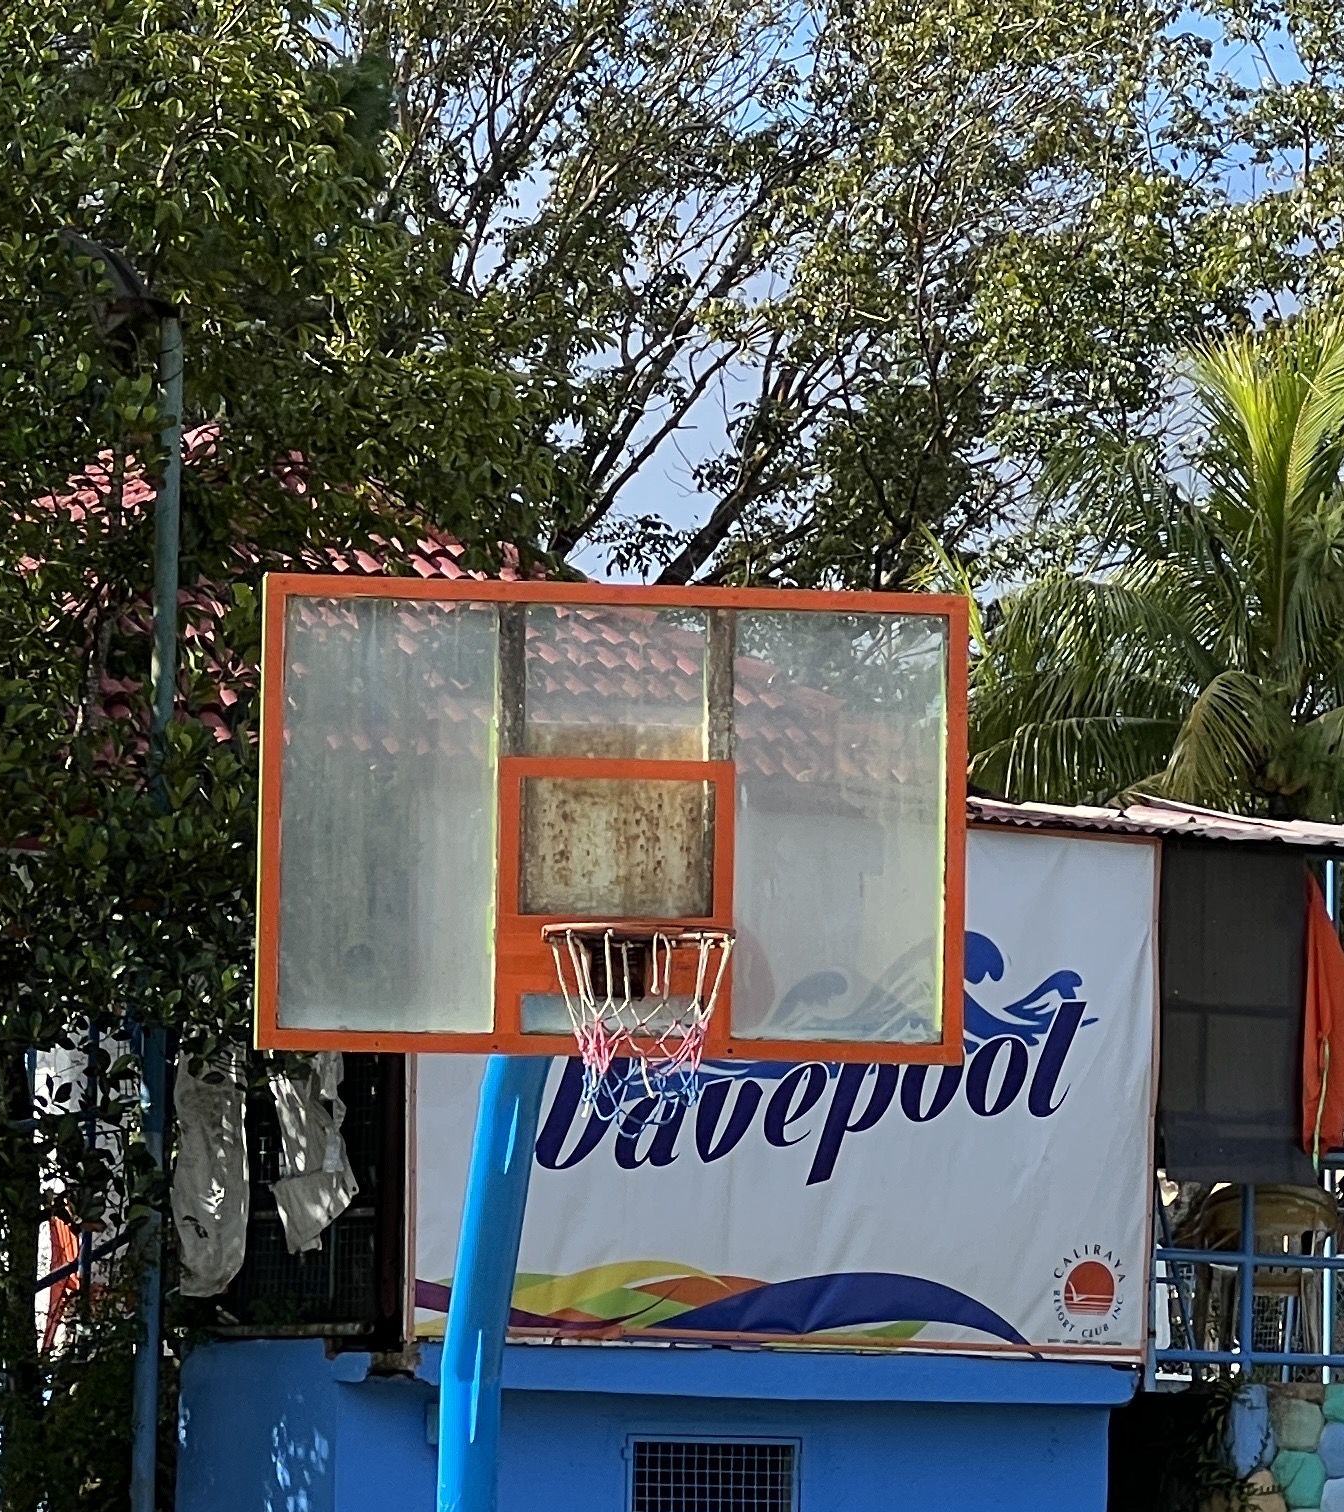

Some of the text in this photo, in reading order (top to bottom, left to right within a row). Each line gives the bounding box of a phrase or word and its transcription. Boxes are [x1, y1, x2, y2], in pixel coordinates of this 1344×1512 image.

[1053, 1244, 1126, 1283] CALIRAYA
[1053, 1290, 1075, 1332] RESORT
[1081, 1323, 1110, 1338] CLUB
